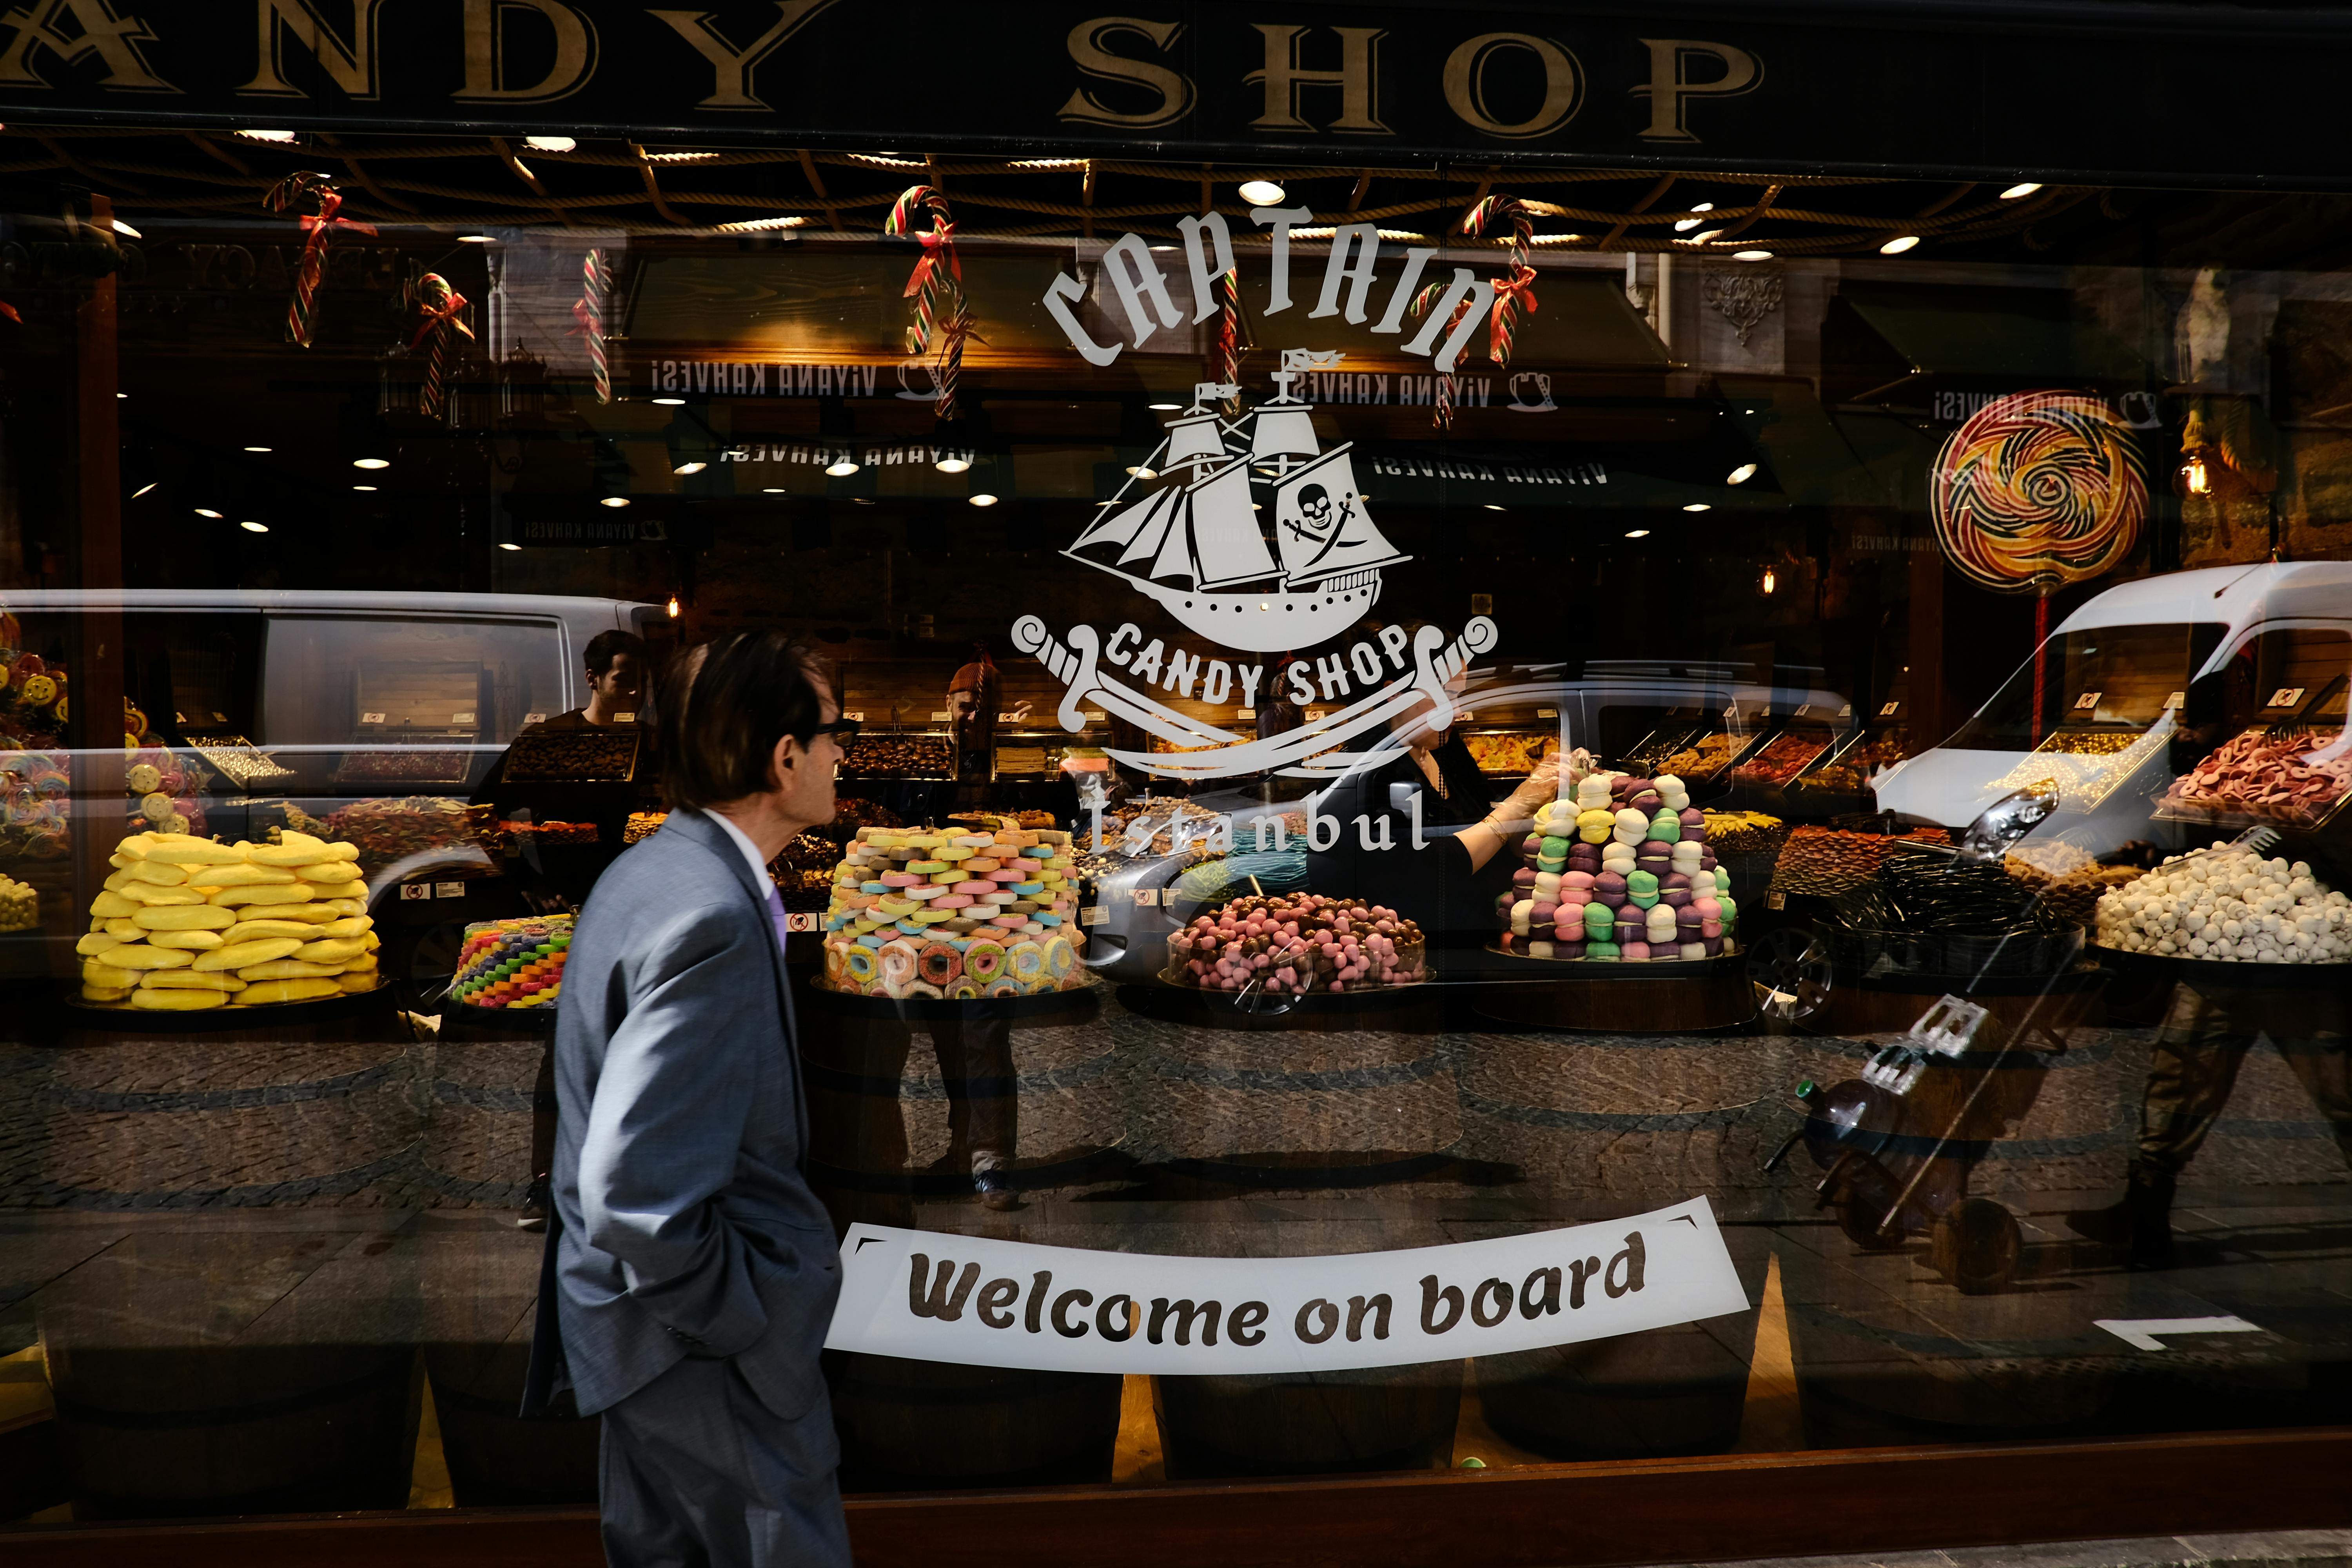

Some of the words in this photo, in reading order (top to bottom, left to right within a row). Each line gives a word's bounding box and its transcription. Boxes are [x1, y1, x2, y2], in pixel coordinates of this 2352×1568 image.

[1056, 16, 1765, 144] SHOP
[1043, 205, 1494, 373] CAPTAIN
[1105, 622, 1264, 709] CANDY
[1287, 624, 1408, 706] SHOP
[909, 1252, 1269, 1347] Welcome
[1294, 1293, 1391, 1345] on
[1420, 1231, 1648, 1336] board
